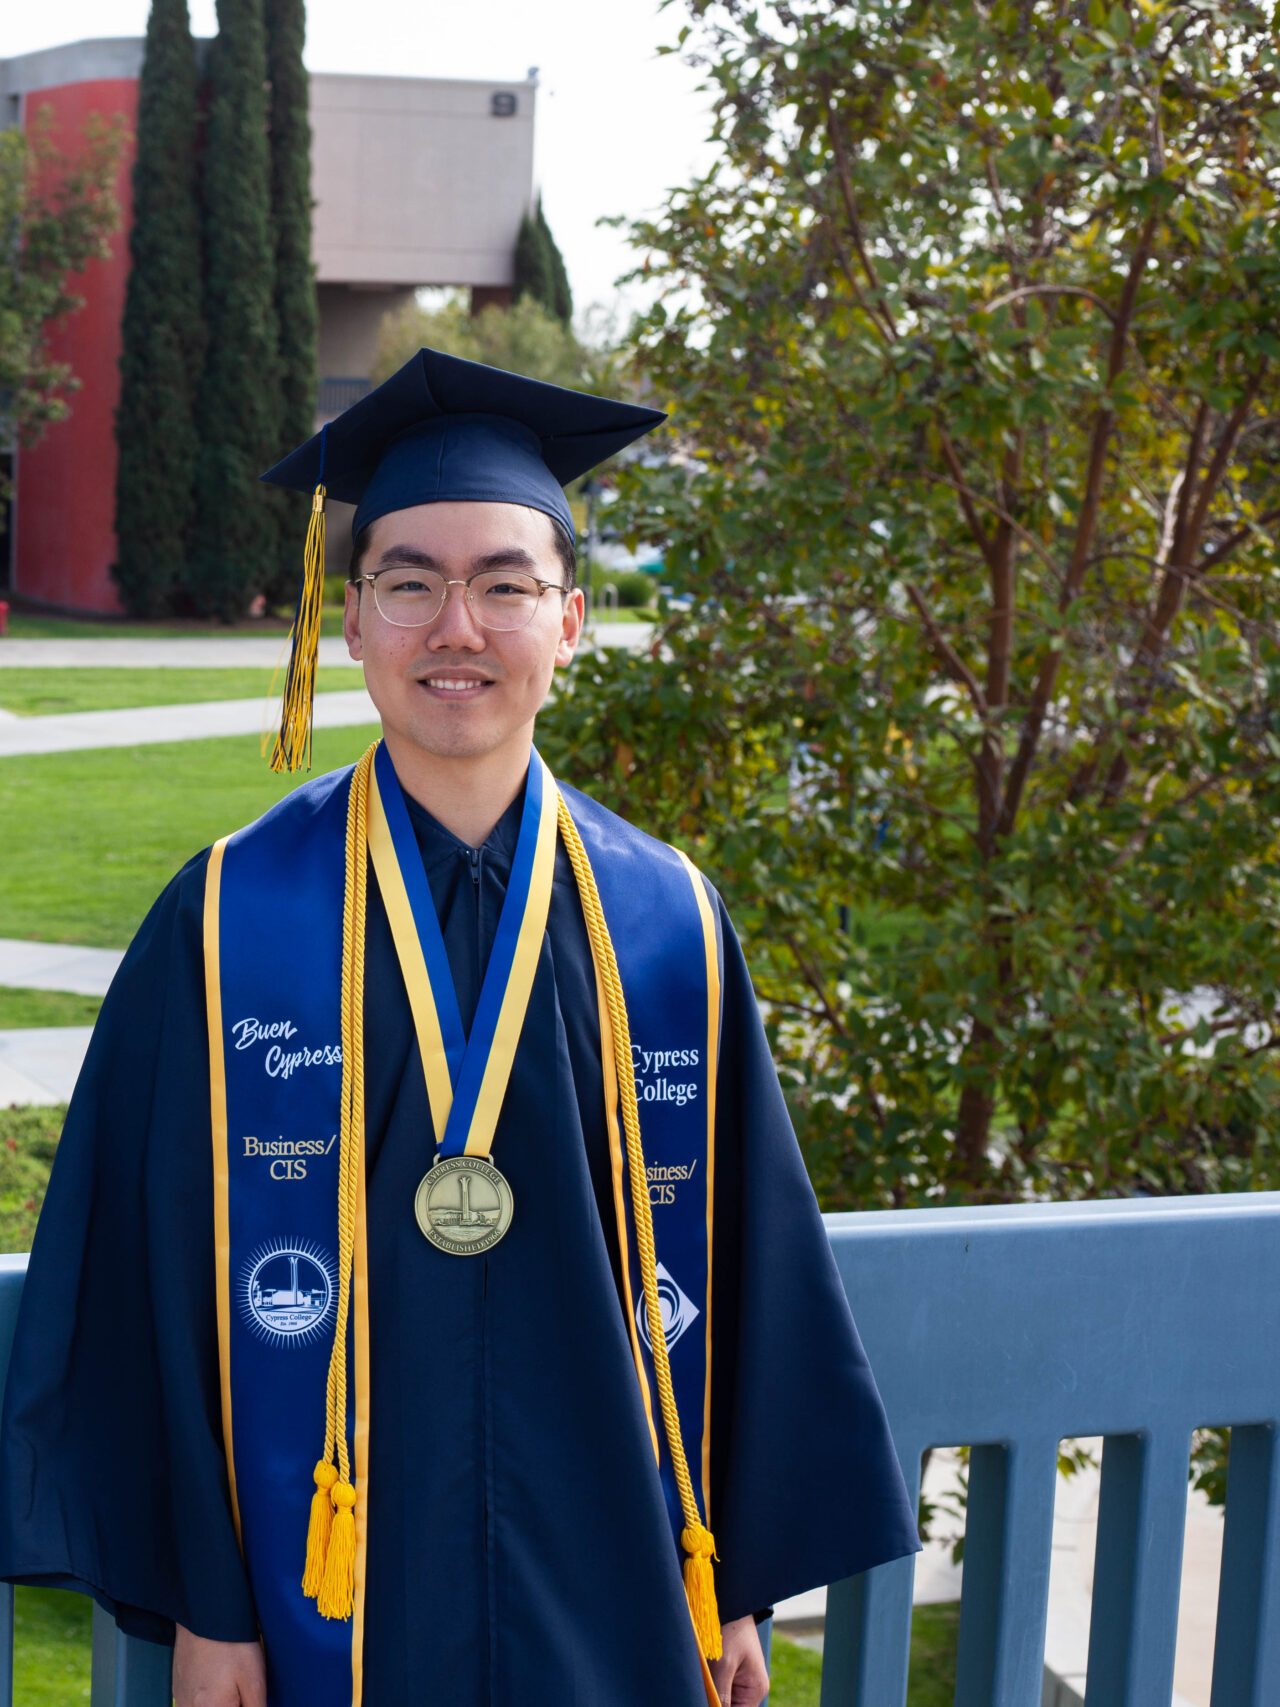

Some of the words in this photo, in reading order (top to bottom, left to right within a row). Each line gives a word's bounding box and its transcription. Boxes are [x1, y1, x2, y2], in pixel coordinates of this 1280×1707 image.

[232, 1017, 298, 1050] Buen
[265, 1045, 343, 1080] Cypress
[630, 1044, 699, 1073] Cypress
[634, 1078, 698, 1106] College
[243, 1135, 336, 1157] Business/
[270, 1159, 307, 1180] CIS
[427, 1161, 460, 1186] CYPRESS
[462, 1160, 502, 1186] COLLEGE
[645, 1159, 697, 1181] siness/
[648, 1184, 675, 1205] CIS
[429, 1229, 484, 1252] ESTABLISHED
[485, 1230, 502, 1246] 1966
[266, 1314, 288, 1322] Cypress
[289, 1314, 312, 1322] College
